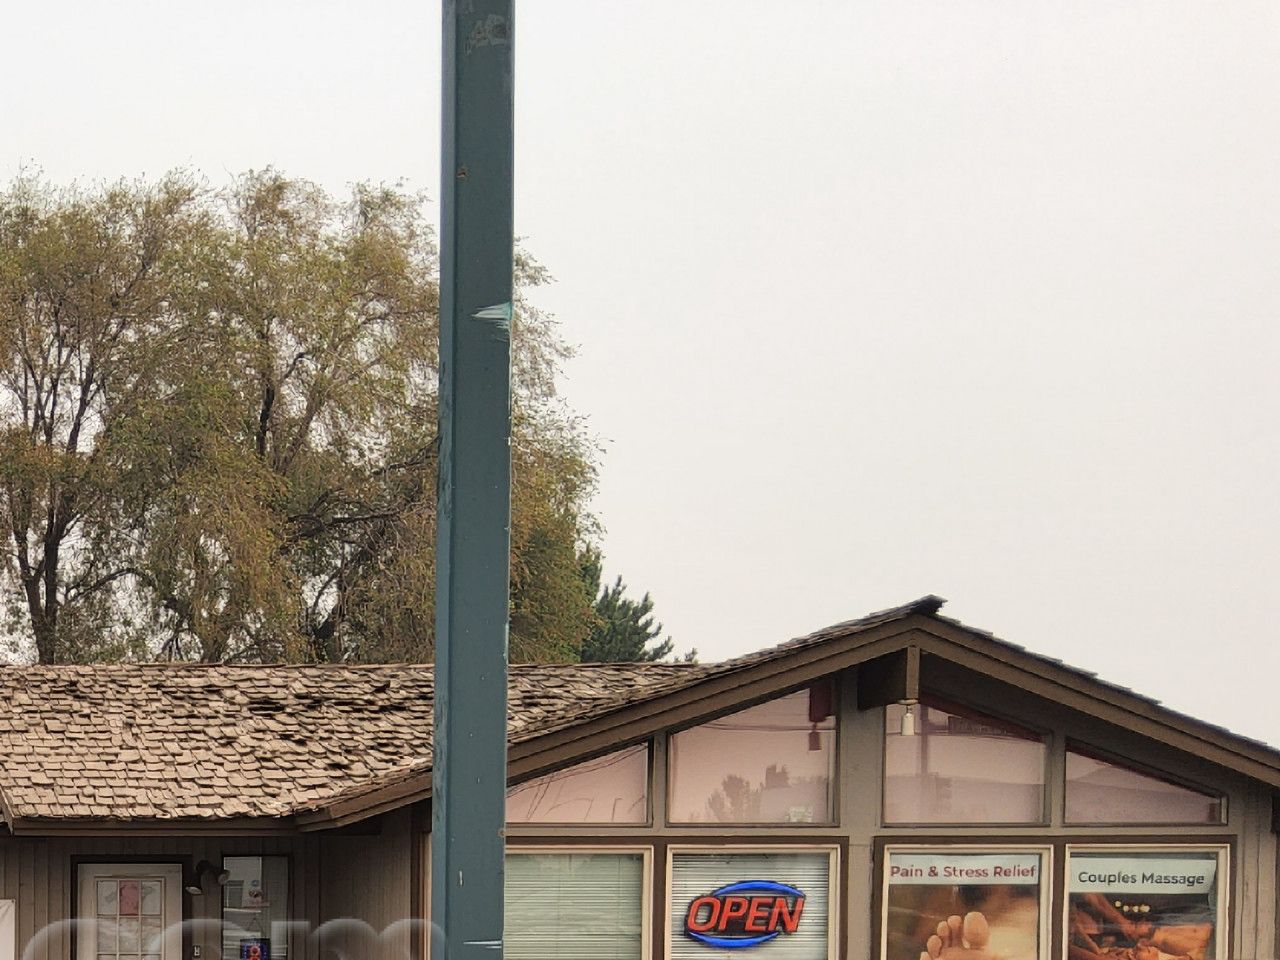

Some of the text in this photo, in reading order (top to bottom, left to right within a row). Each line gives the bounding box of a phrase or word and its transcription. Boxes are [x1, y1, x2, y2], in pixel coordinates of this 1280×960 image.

[890, 864, 1037, 879] Pain & Stress Relief
[1078, 871, 1205, 886] Couples Massage
[686, 895, 806, 933] OPEN
